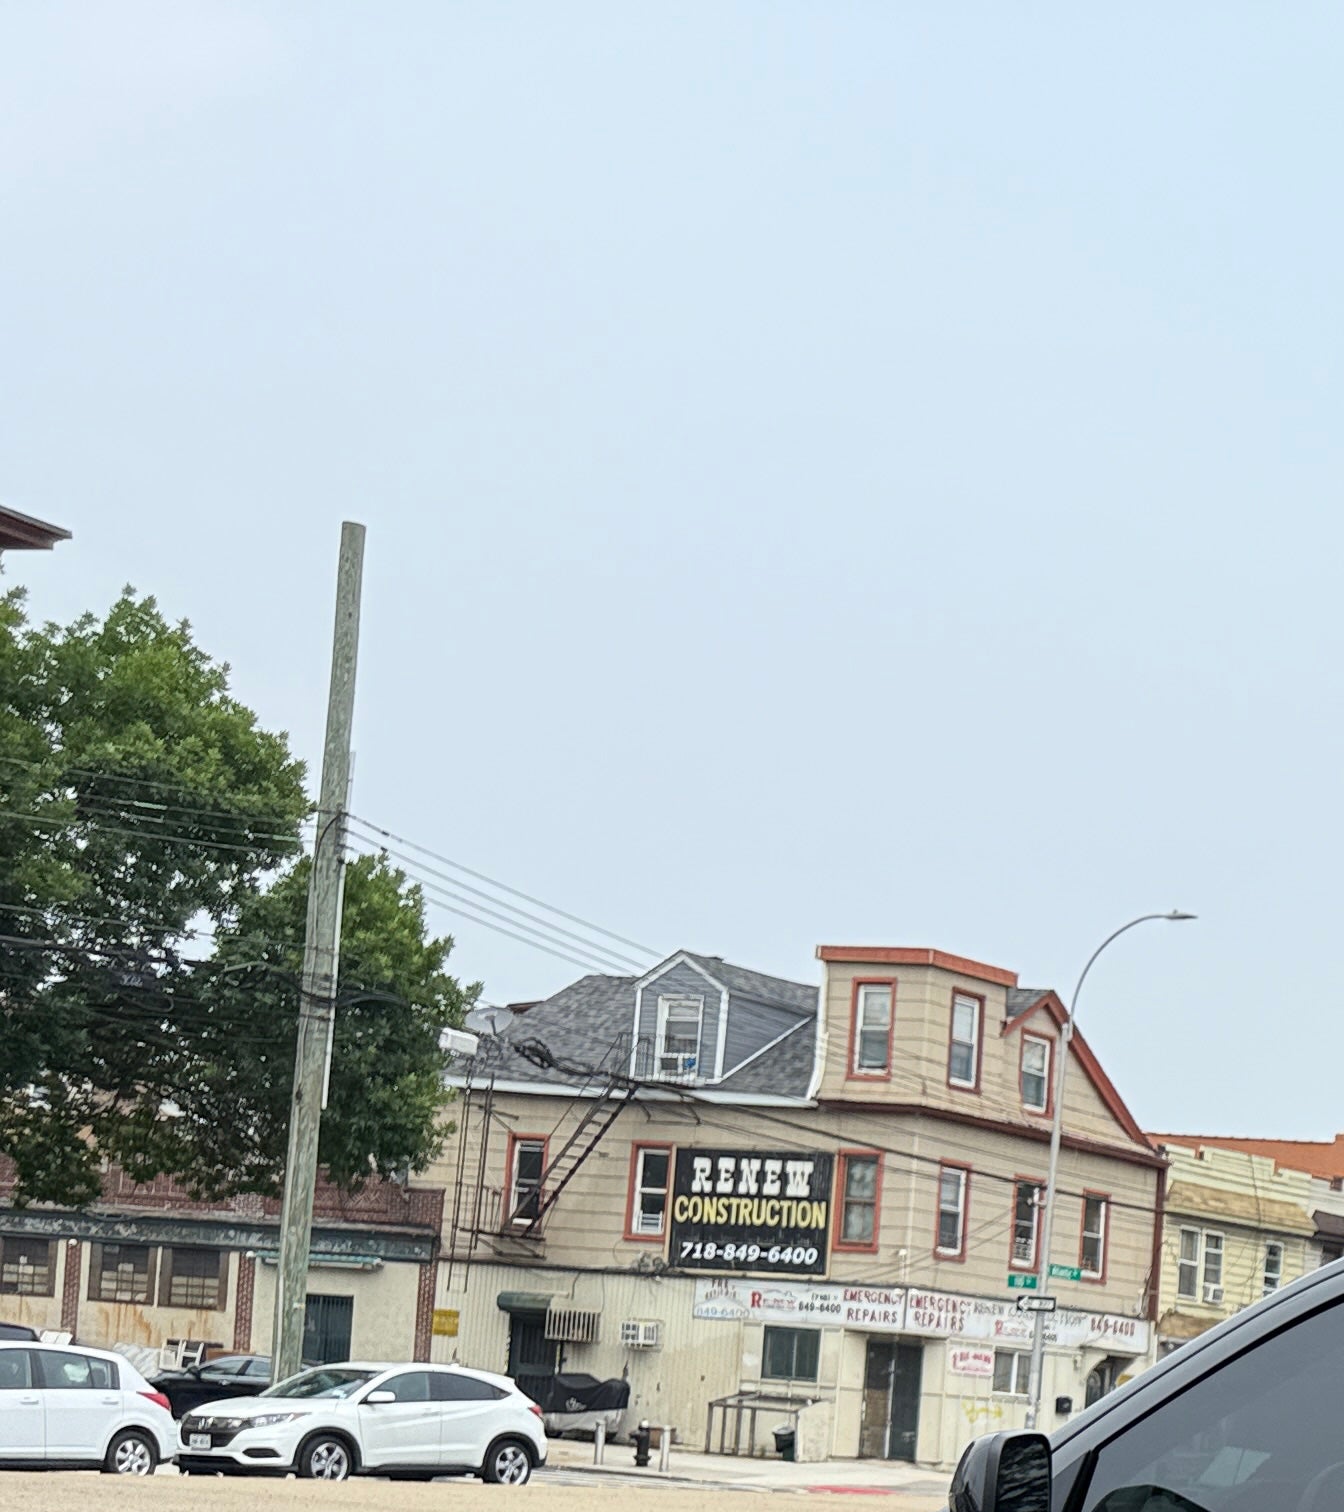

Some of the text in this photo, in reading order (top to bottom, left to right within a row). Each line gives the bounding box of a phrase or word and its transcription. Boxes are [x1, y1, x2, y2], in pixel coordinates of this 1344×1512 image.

[691, 1156, 814, 1198] RENEW
[673, 1194, 827, 1230] CONSTRUCTION
[679, 1241, 819, 1266] 718-849-6400
[846, 1307, 898, 1324] REPAIRS
[914, 1310, 966, 1333] REPAIRS
